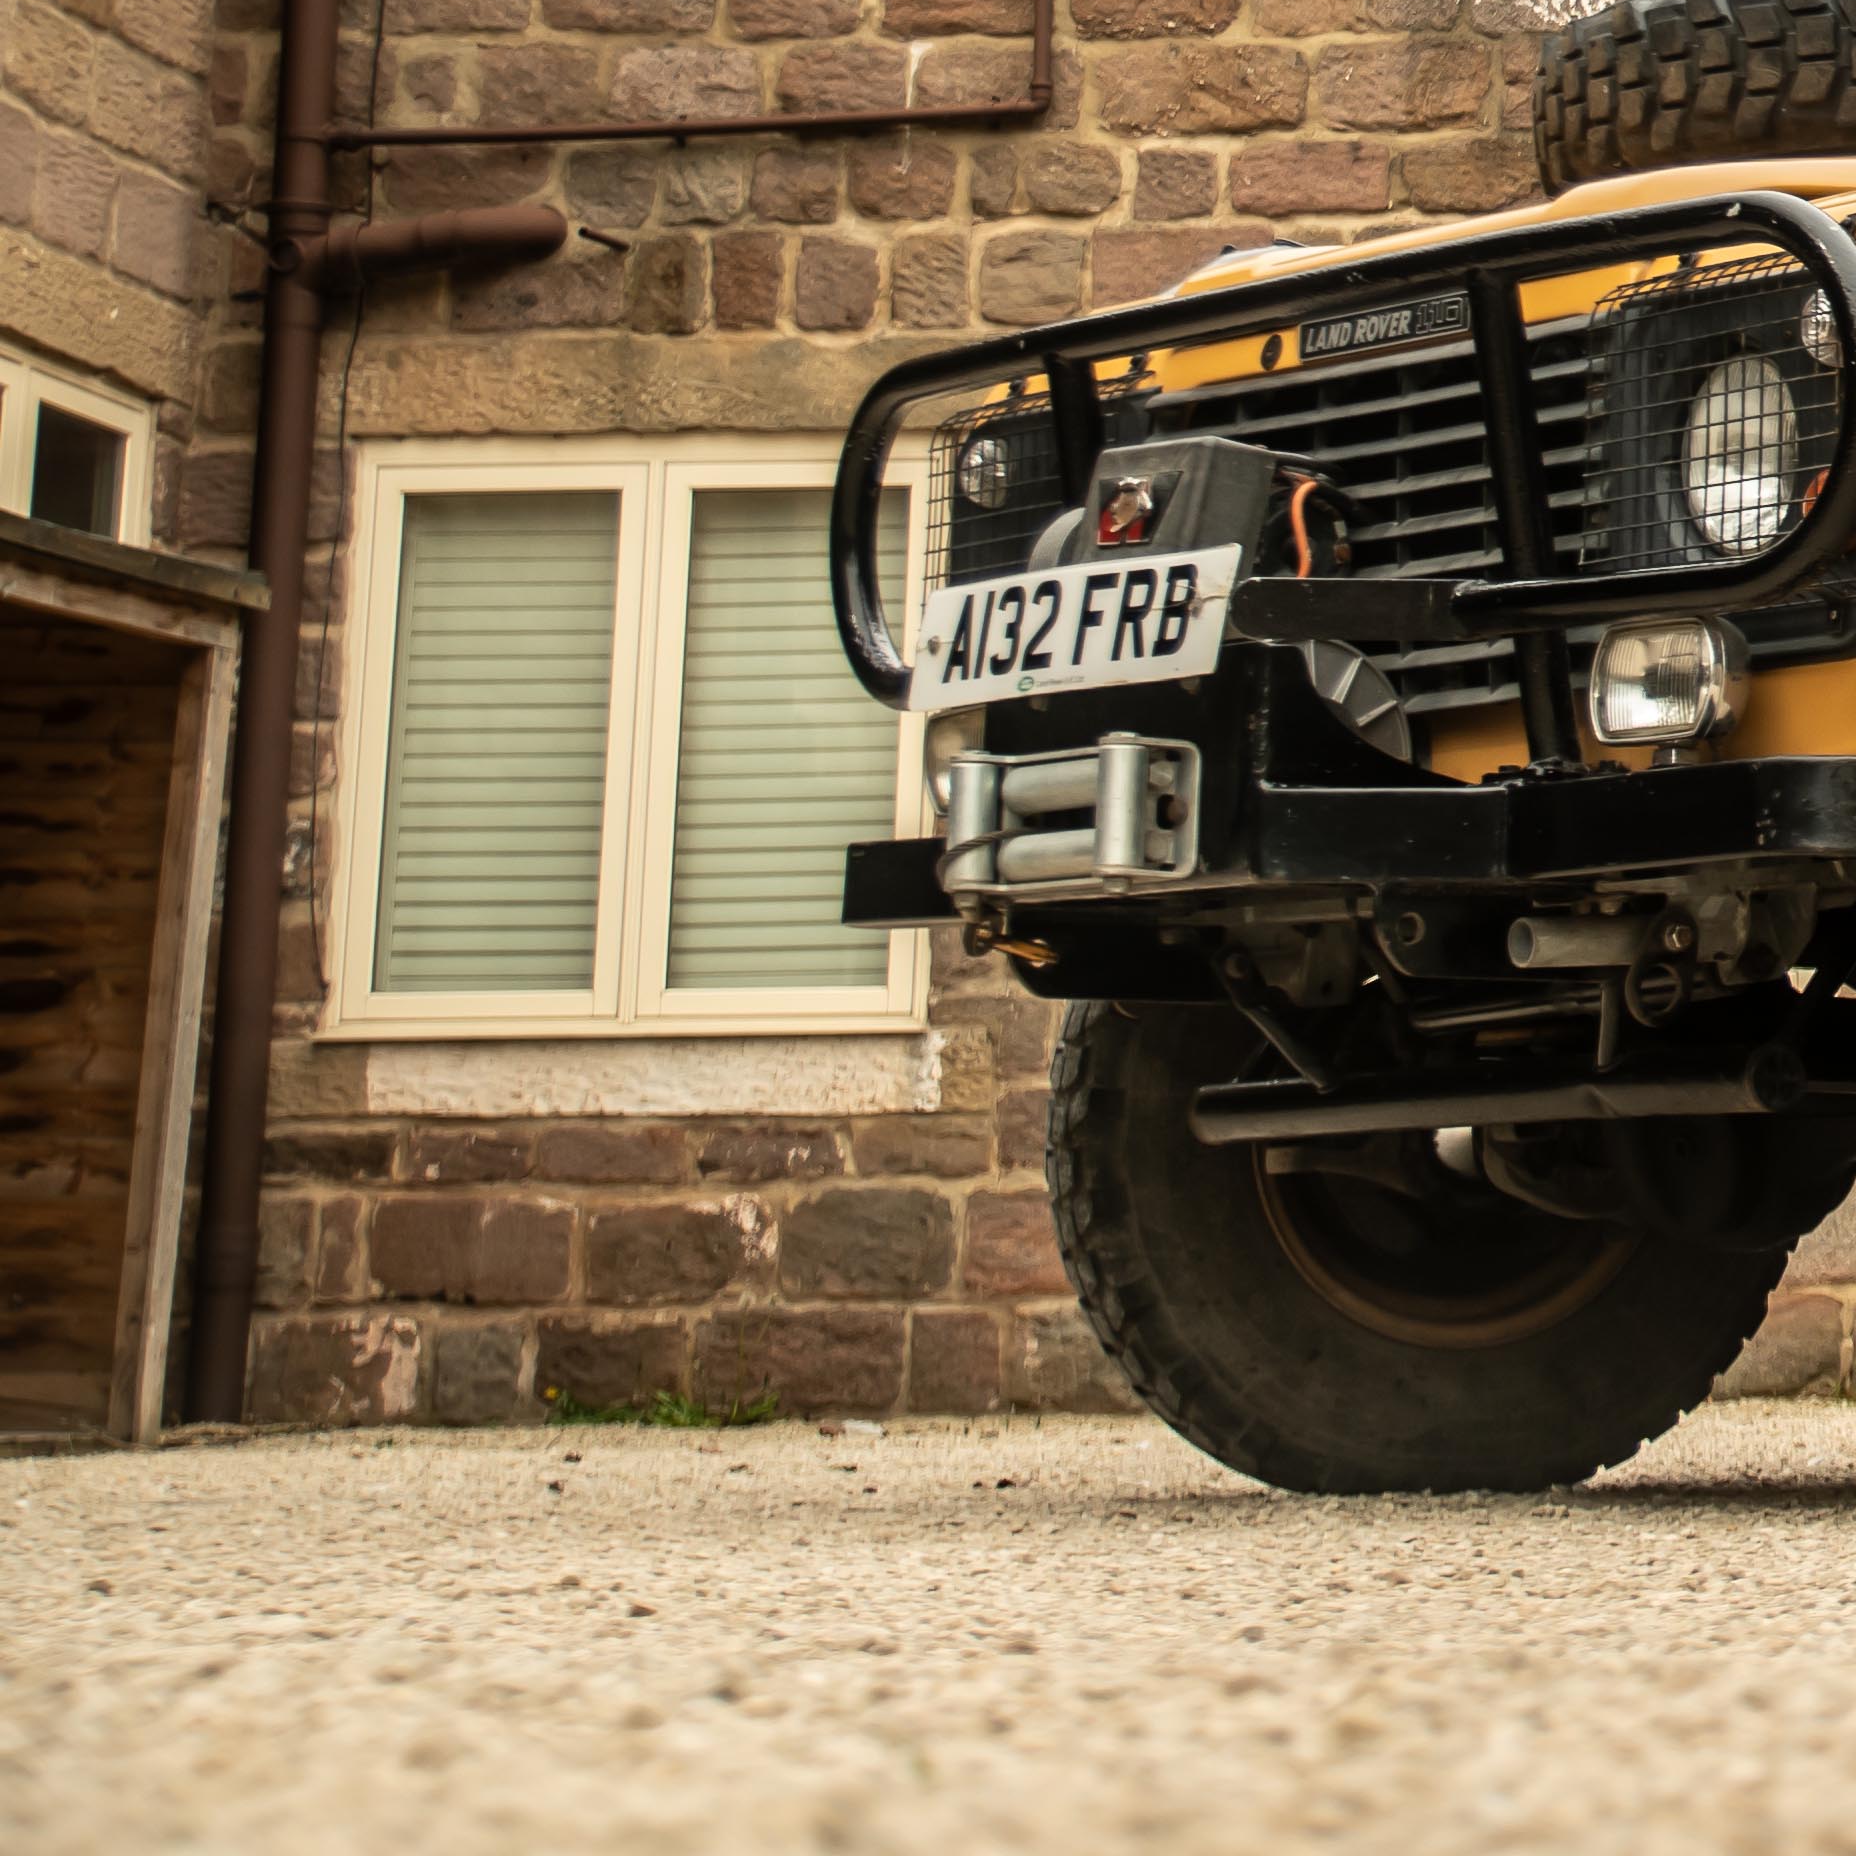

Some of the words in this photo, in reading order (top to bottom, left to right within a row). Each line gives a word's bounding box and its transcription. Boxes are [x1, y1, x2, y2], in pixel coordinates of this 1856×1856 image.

[1304, 322, 1352, 353] LAND
[1353, 310, 1412, 344] ROVER
[941, 578, 1062, 684] A132
[1071, 562, 1198, 666] FRB
